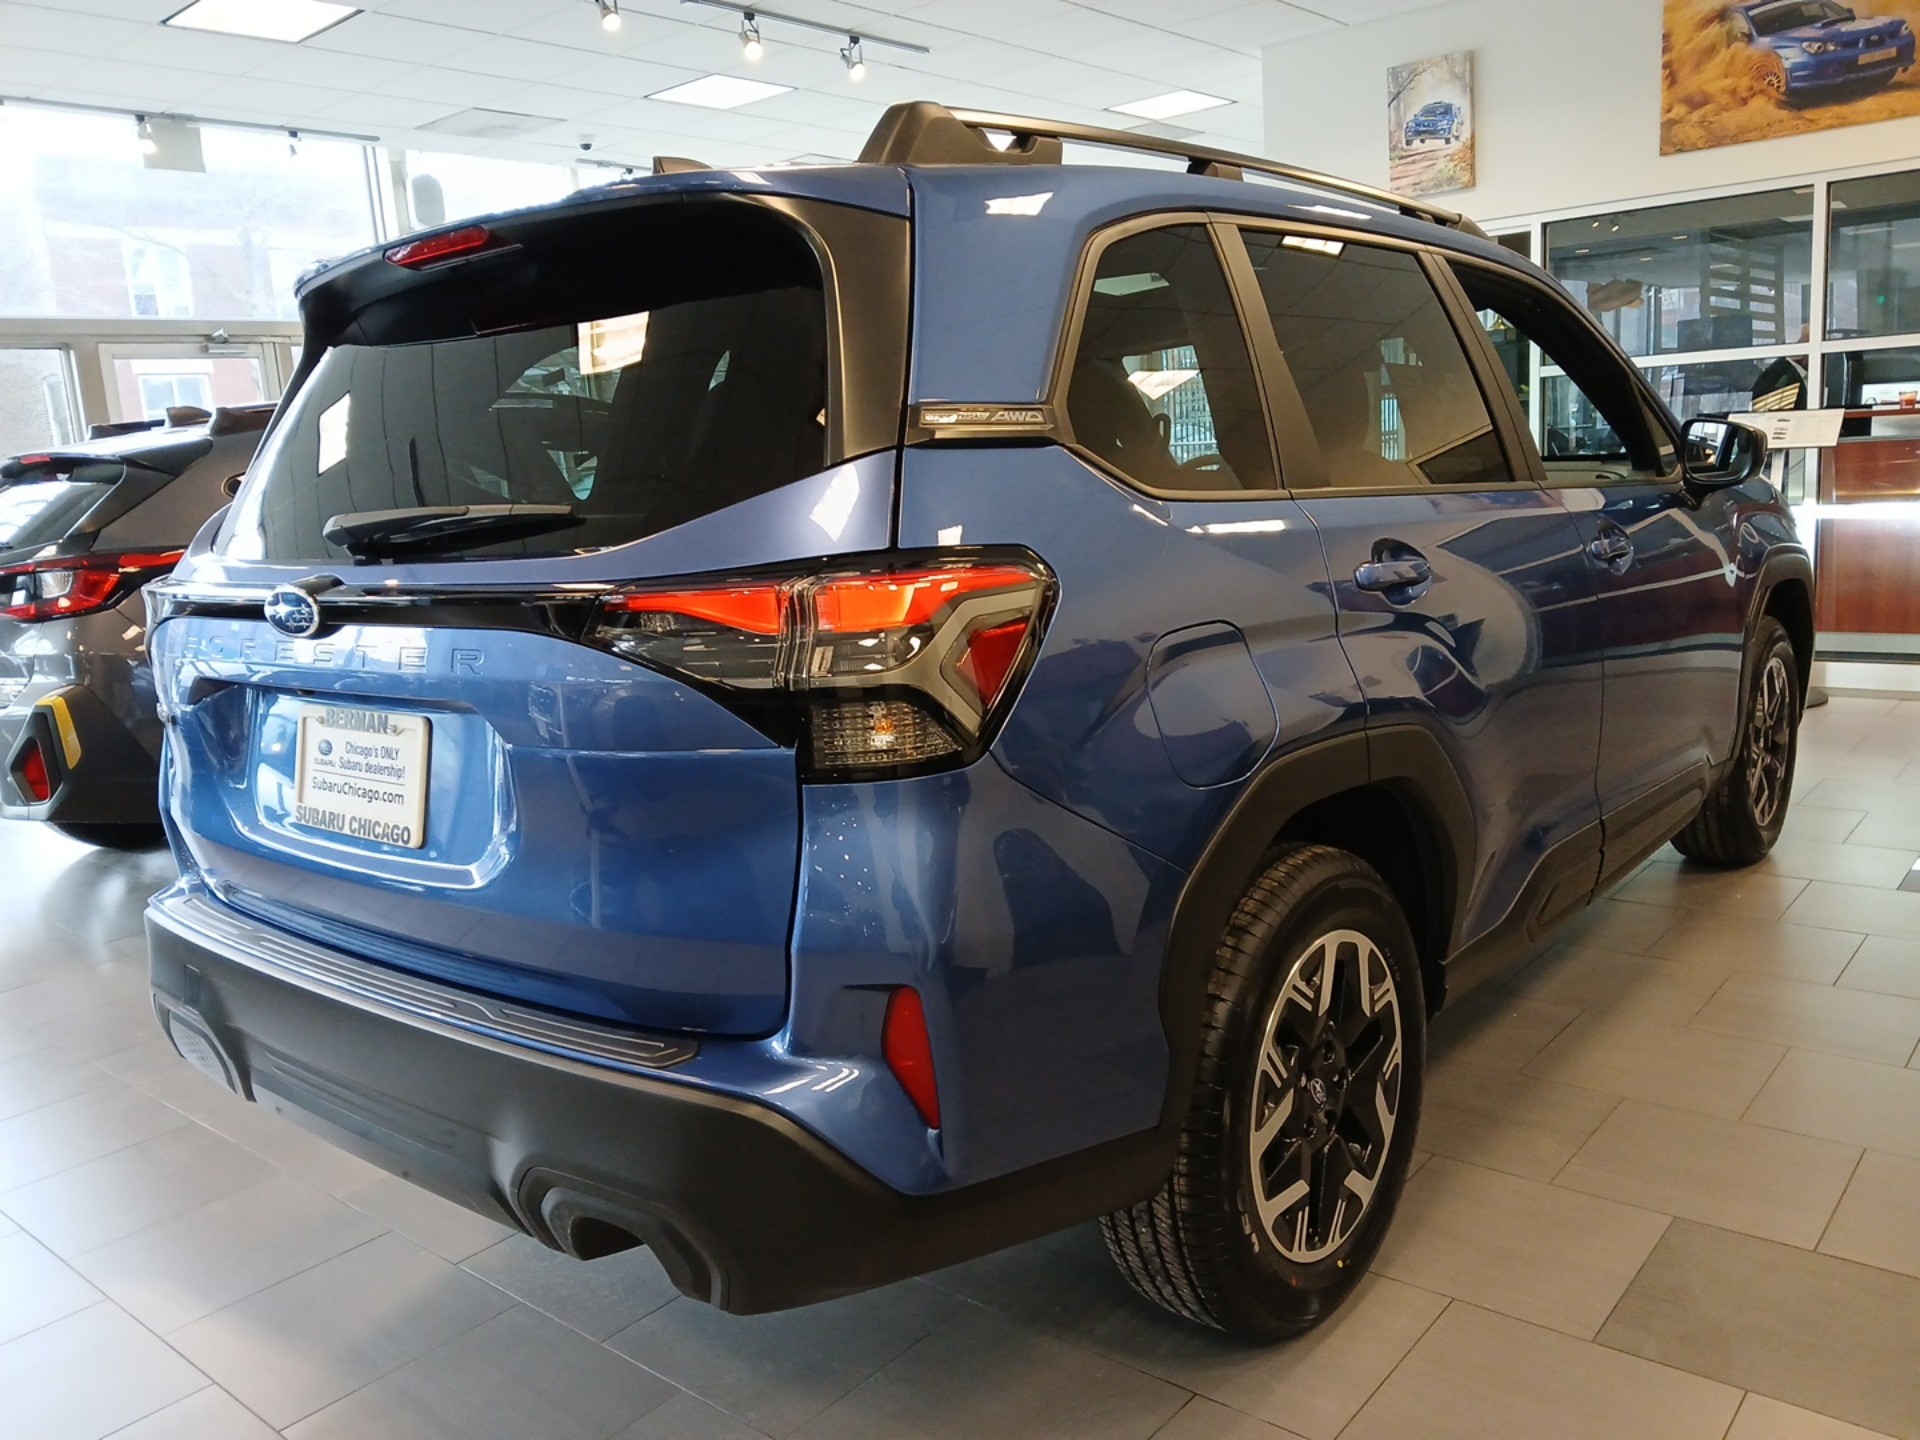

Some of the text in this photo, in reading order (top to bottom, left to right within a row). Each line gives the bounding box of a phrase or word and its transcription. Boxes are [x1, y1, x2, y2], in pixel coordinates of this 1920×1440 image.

[991, 411, 1044, 421] AWD
[325, 708, 389, 734] BERMAN
[345, 741, 400, 761] Chicago's ONLY
[339, 756, 405, 781] Subaru dealership!
[312, 776, 405, 806] SubaruChicago.com
[296, 804, 411, 845] SUBARU CHICAGO
